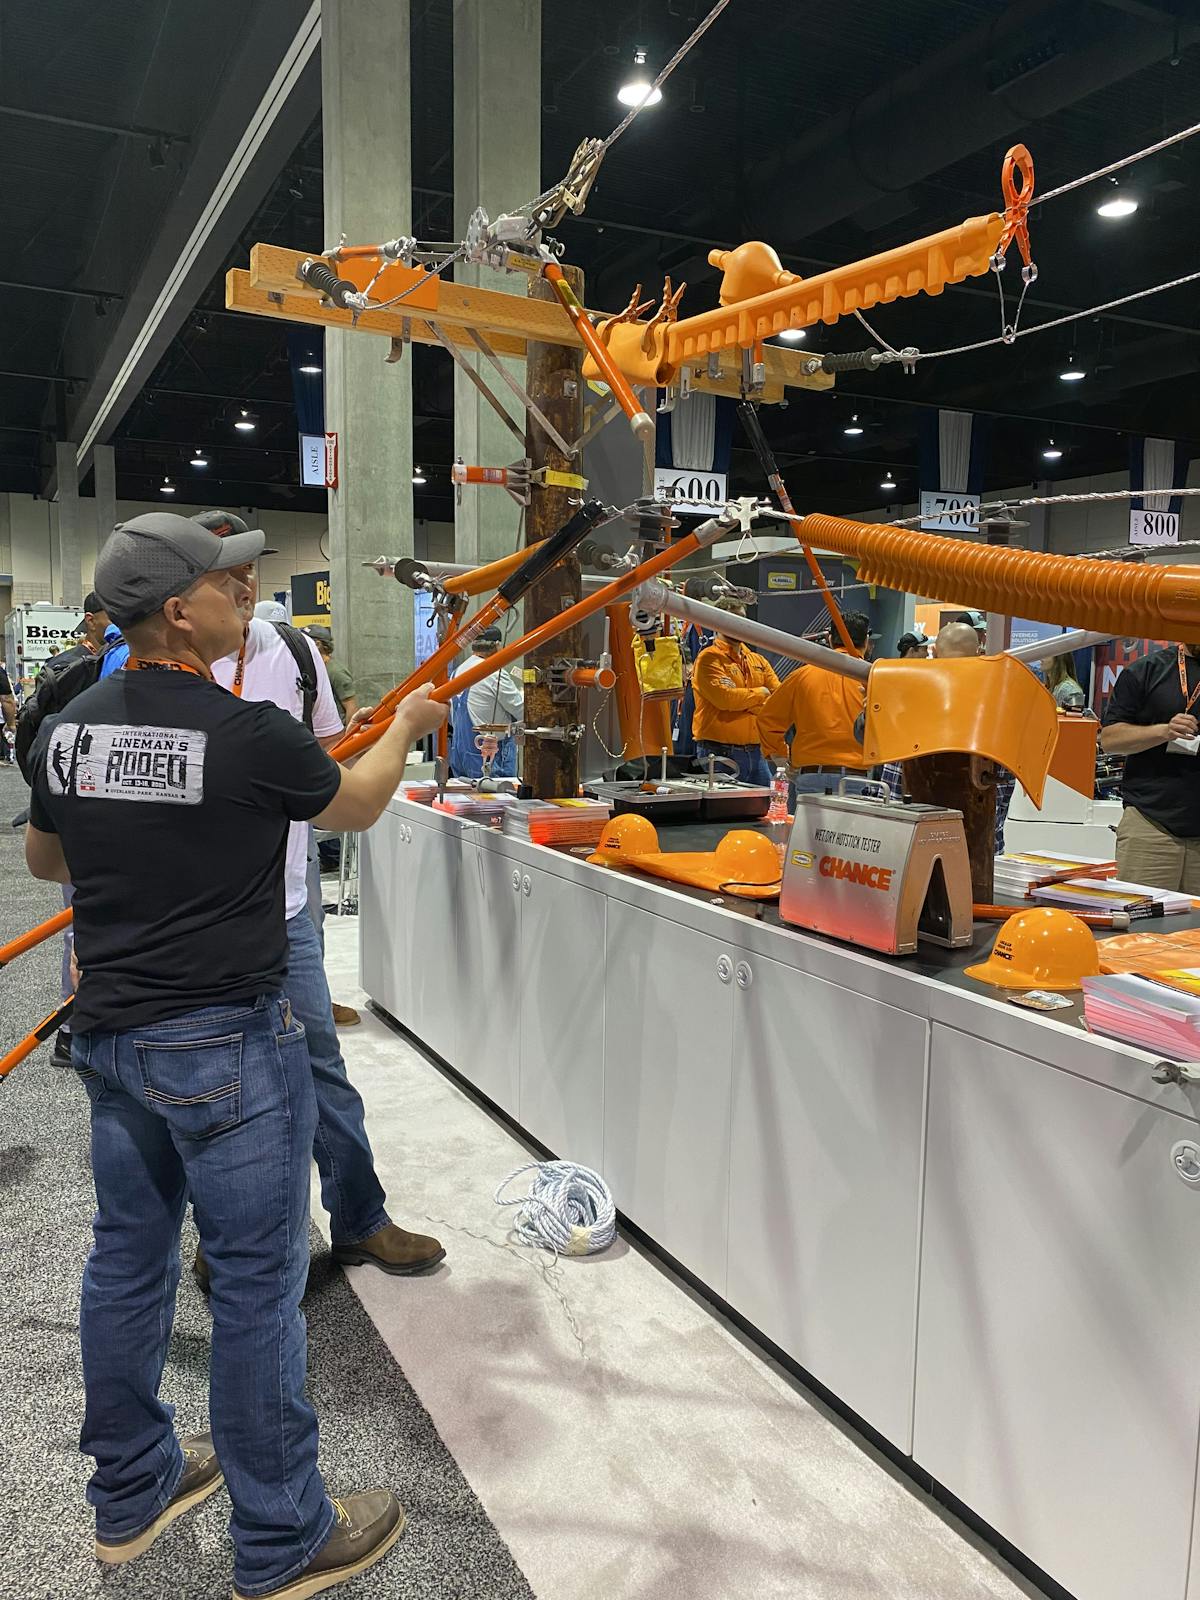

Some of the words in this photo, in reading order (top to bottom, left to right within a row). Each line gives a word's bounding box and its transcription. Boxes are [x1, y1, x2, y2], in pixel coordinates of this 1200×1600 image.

[311, 446, 319, 475] AISLE
[672, 476, 720, 508] 600
[935, 499, 975, 526] 700
[1143, 512, 1176, 537] 800
[26, 626, 81, 638] Biere
[111, 738, 189, 751] LINEMAN'S
[122, 731, 178, 739] INTERNATIONAL
[105, 751, 187, 789] RODEO
[836, 832, 861, 849] HOTSTICK
[861, 837, 881, 853] TESTER
[819, 856, 892, 891] CHANCE
